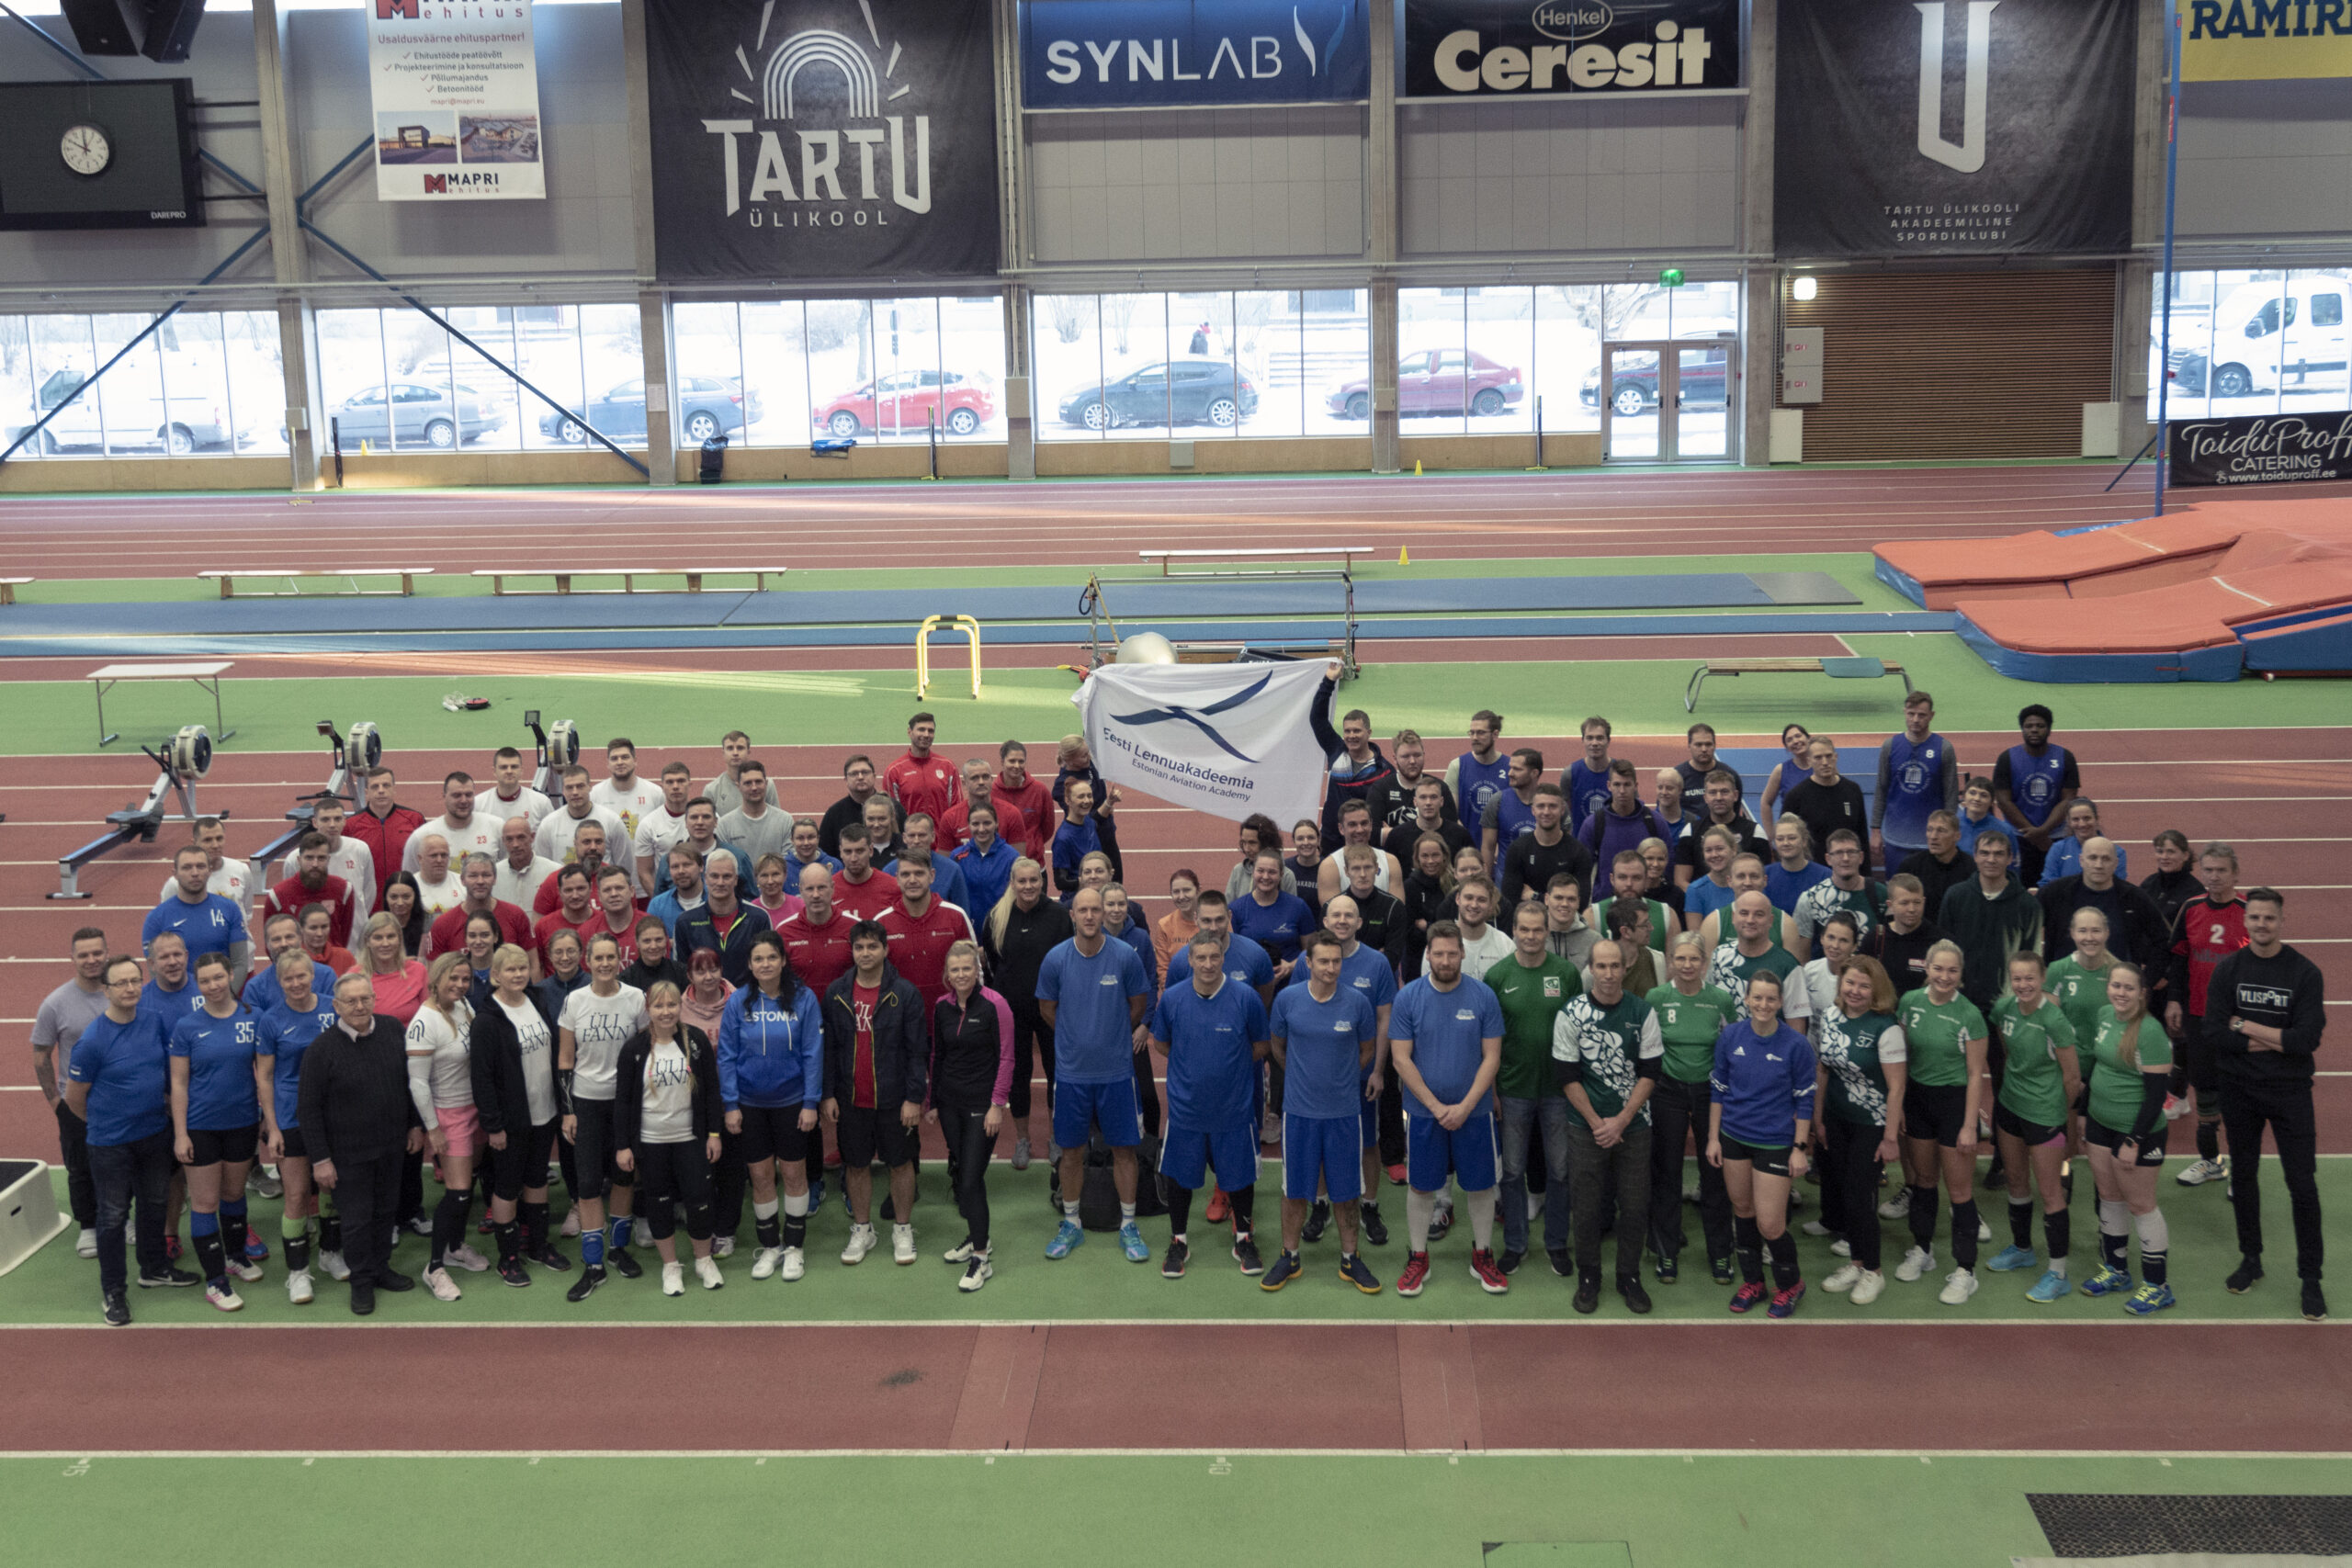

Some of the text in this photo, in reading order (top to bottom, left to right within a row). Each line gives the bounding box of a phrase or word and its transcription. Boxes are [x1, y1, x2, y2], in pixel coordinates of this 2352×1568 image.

[424, 6, 524, 19] ehitus
[1540, 8, 1606, 27] Henkel
[2189, 0, 2352, 39] RAMIR
[378, 32, 526, 44] Usaldusväärne ehituspartner!
[1046, 37, 1283, 84] SYNLAB
[1433, 19, 1712, 92] Ceresit
[394, 63, 457, 73] Projekteerimine
[466, 62, 525, 71] konsultatsioon
[431, 74, 489, 84] Põllumajandus
[437, 85, 484, 94] Betoonitööd
[430, 97, 485, 106] mapri@mapri.eu
[700, 115, 932, 217] TARTU
[448, 173, 499, 186] MAPRI
[151, 211, 187, 220] DAREPRO
[1883, 203, 2020, 215] TARTU ÜLIKOOLI
[750, 209, 888, 228] ÜLIKOOL
[1890, 217, 2013, 229] AKADEEMILINE
[1896, 231, 2007, 242] SPORDIKLUBI
[2231, 454, 2322, 472] CATERING
[2228, 469, 2337, 484] www.toiduproff.ee
[1103, 727, 1255, 790] Eesti Lennuakadeemia
[1926, 750, 1935, 759] 8
[2050, 760, 2060, 769] 3
[1132, 758, 1251, 803] Estonian Aviation Academy
[1498, 769, 1508, 779] 2
[477, 835, 487, 845] 23
[210, 908, 226, 927] 14
[2210, 924, 2225, 944] 2
[2067, 982, 2078, 997] 9
[2239, 989, 2290, 1008] YLISPORT
[589, 1012, 619, 1029] ÜLI
[1668, 1009, 1677, 1024] 8
[1910, 1013, 1920, 1028] 2
[235, 1021, 255, 1044] 35
[582, 1025, 630, 1043] FANN
[1855, 1035, 1875, 1048] 37
[656, 1057, 685, 1076] ÜLI
